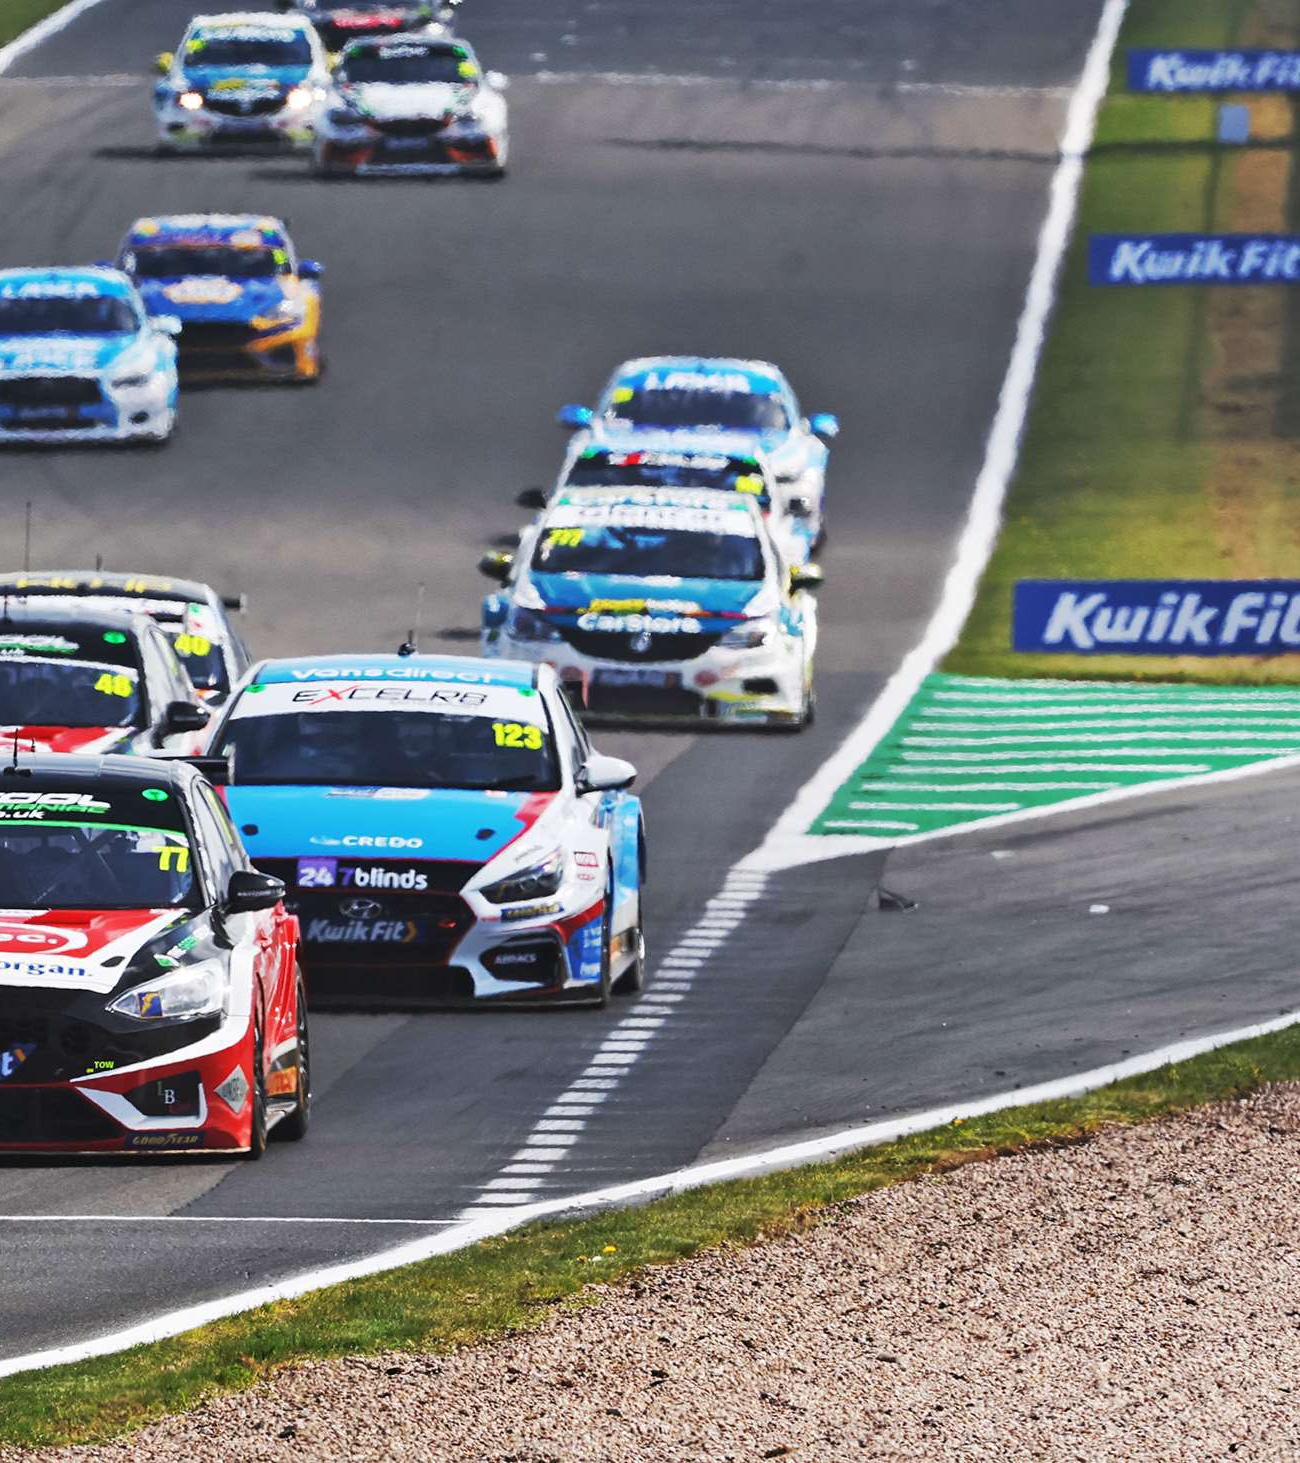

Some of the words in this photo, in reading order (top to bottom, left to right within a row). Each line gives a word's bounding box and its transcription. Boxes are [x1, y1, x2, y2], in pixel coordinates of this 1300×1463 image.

[1109, 240, 1236, 283] Kwik
[1042, 591, 1219, 650] Kwik
[291, 667, 492, 684] vansdirect
[492, 722, 543, 751] 123
[342, 835, 424, 849] CREDO
[154, 845, 190, 873] 77
[306, 918, 369, 942] Kwik
[369, 920, 406, 941] Fit
[94, 1060, 115, 1070] TOW
